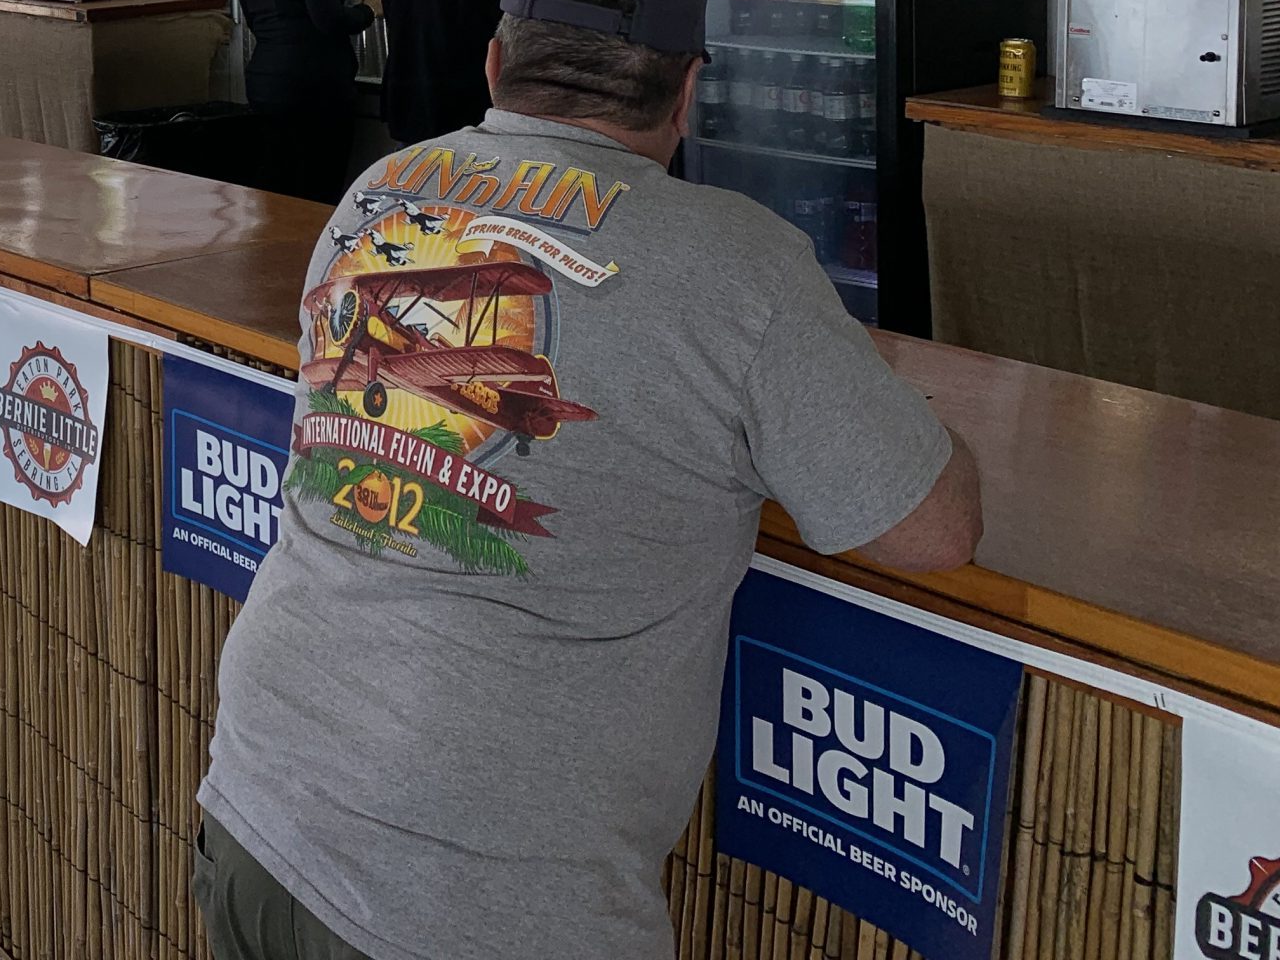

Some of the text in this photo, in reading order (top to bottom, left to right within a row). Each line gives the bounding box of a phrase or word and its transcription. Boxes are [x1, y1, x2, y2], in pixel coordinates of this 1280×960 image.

[465, 223, 607, 283] SPRING BREAK FOR PILOTS!
[16, 357, 82, 413] EATON PARK
[52, 411, 97, 457] LITTLE
[303, 415, 512, 513] INTERNATIONAL FLY-IN & EXPO
[67, 460, 79, 481] FL
[196, 429, 279, 500] BUD
[172, 527, 257, 573] AN OFFICIAL BEER
[380, 532, 418, 557] Florida
[782, 667, 946, 785] BUD
[752, 716, 975, 871] LIGHT
[737, 794, 978, 936] AN OFFICIAL BEER SPONSOR
